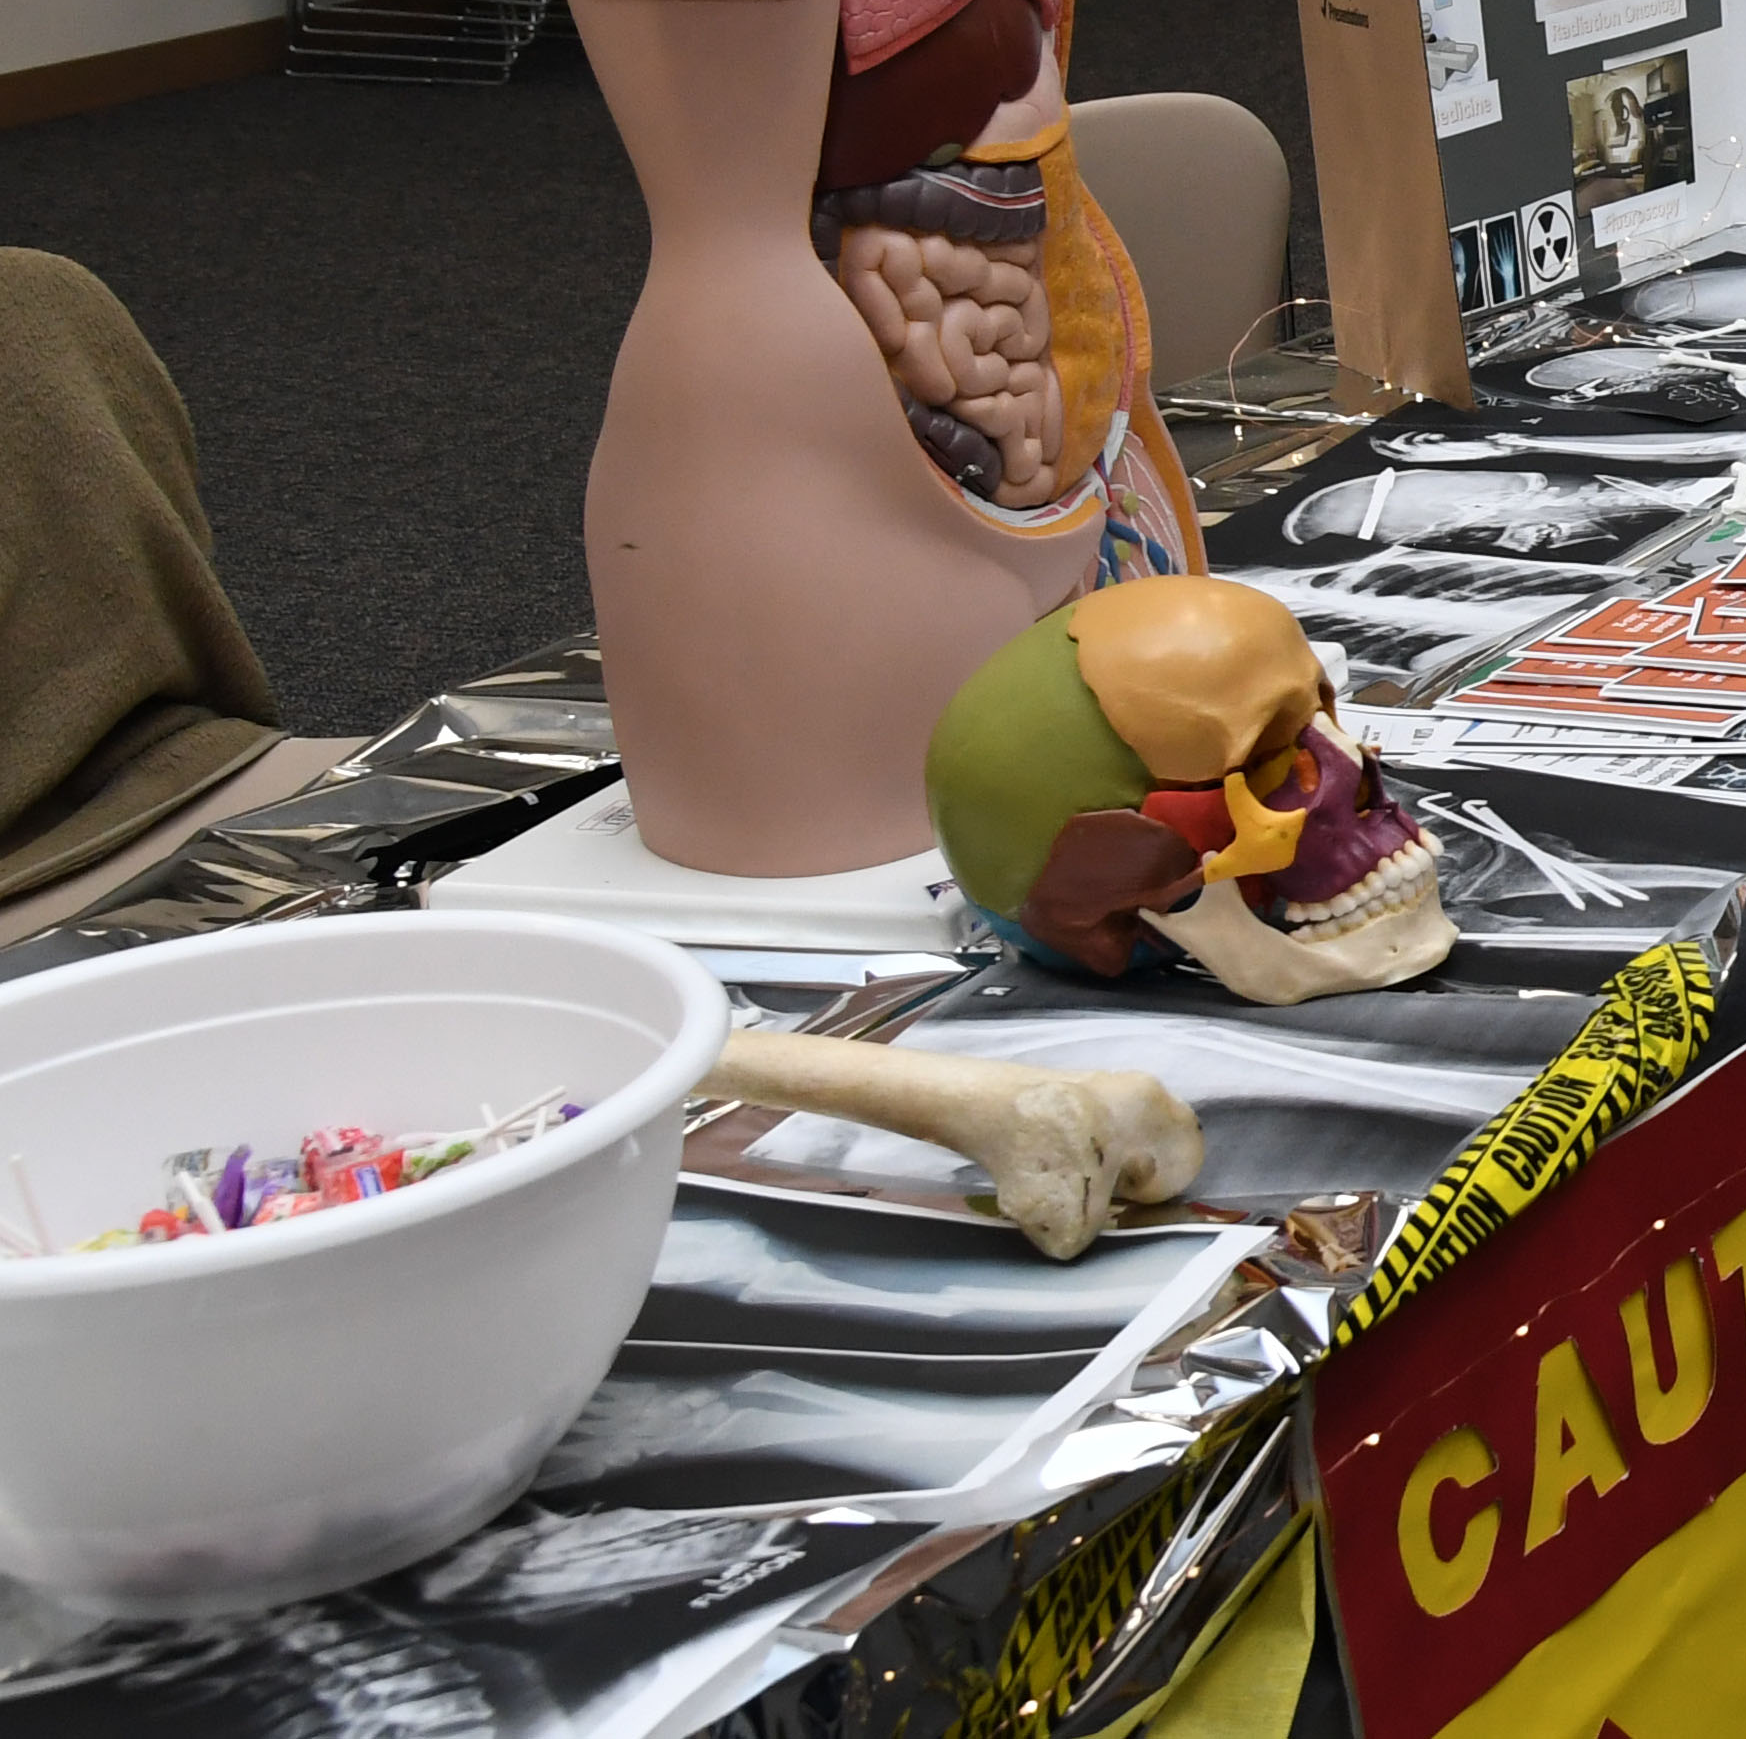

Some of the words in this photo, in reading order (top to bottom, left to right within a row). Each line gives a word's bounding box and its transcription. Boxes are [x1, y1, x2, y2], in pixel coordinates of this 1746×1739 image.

[1551, 12, 1622, 43] Radiation
[1490, 1073, 1598, 1192] CAUTION
[1399, 1181, 1510, 1301] UTION
